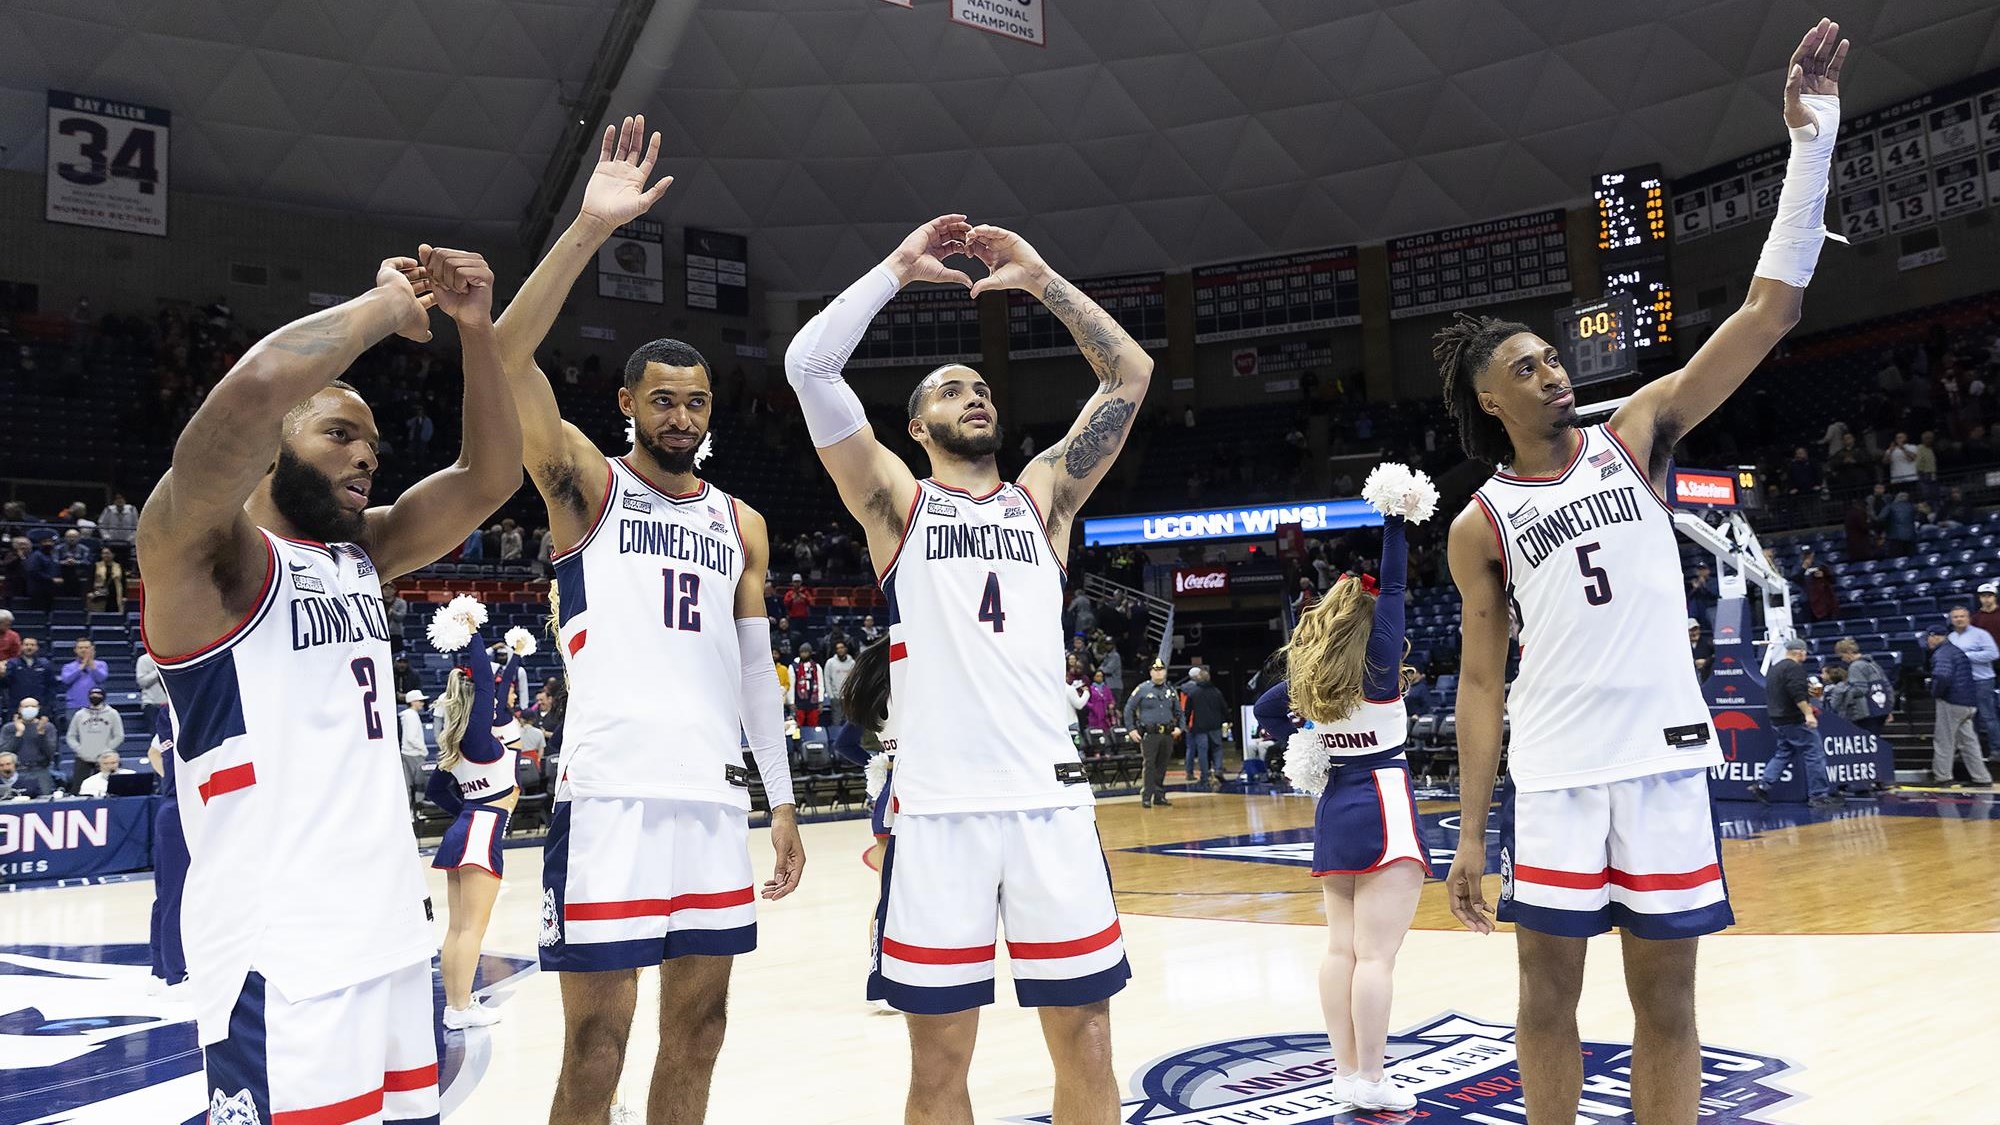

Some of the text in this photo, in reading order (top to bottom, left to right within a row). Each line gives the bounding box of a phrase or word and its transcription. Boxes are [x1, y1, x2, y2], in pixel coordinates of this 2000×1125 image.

[966, 0, 1029, 22] NATIONAL
[962, 10, 1035, 38] CHAMPIONS
[74, 97, 145, 120] RAY ALLEN
[58, 118, 158, 195] 34
[1737, 150, 1781, 169] UCONN
[1888, 140, 1921, 165] 44
[1843, 156, 1873, 180] 42
[1944, 181, 1975, 207] 22
[1725, 201, 1735, 218] 9
[1896, 197, 1923, 219] 13
[1396, 212, 1555, 250] NCAA CHAMPIONSHIP
[1684, 212, 1699, 231] C
[1848, 210, 1879, 234] 24
[895, 290, 969, 302] CONFERENC
[1601, 462, 1616, 473] BIG
[1601, 463, 1623, 478] EAST
[1143, 506, 1328, 540] UCONN WINS!
[1516, 487, 1642, 569] CONNECTICUT
[620, 519, 734, 581] CONNECTICUT
[926, 523, 1039, 566] CONNECTICUT
[1184, 573, 1228, 590] Coca-Cola
[1575, 542, 1612, 606] 5
[662, 568, 700, 632] 12
[978, 572, 1006, 633] 4
[1714, 668, 1743, 676] TRAVELERS
[351, 656, 384, 740] 2
[1824, 735, 1878, 756] CHAELS
[1826, 762, 1877, 782] WELERS
[1417, 1044, 1506, 1075] MEN'S
[1446, 1076, 1522, 1103] 2004
